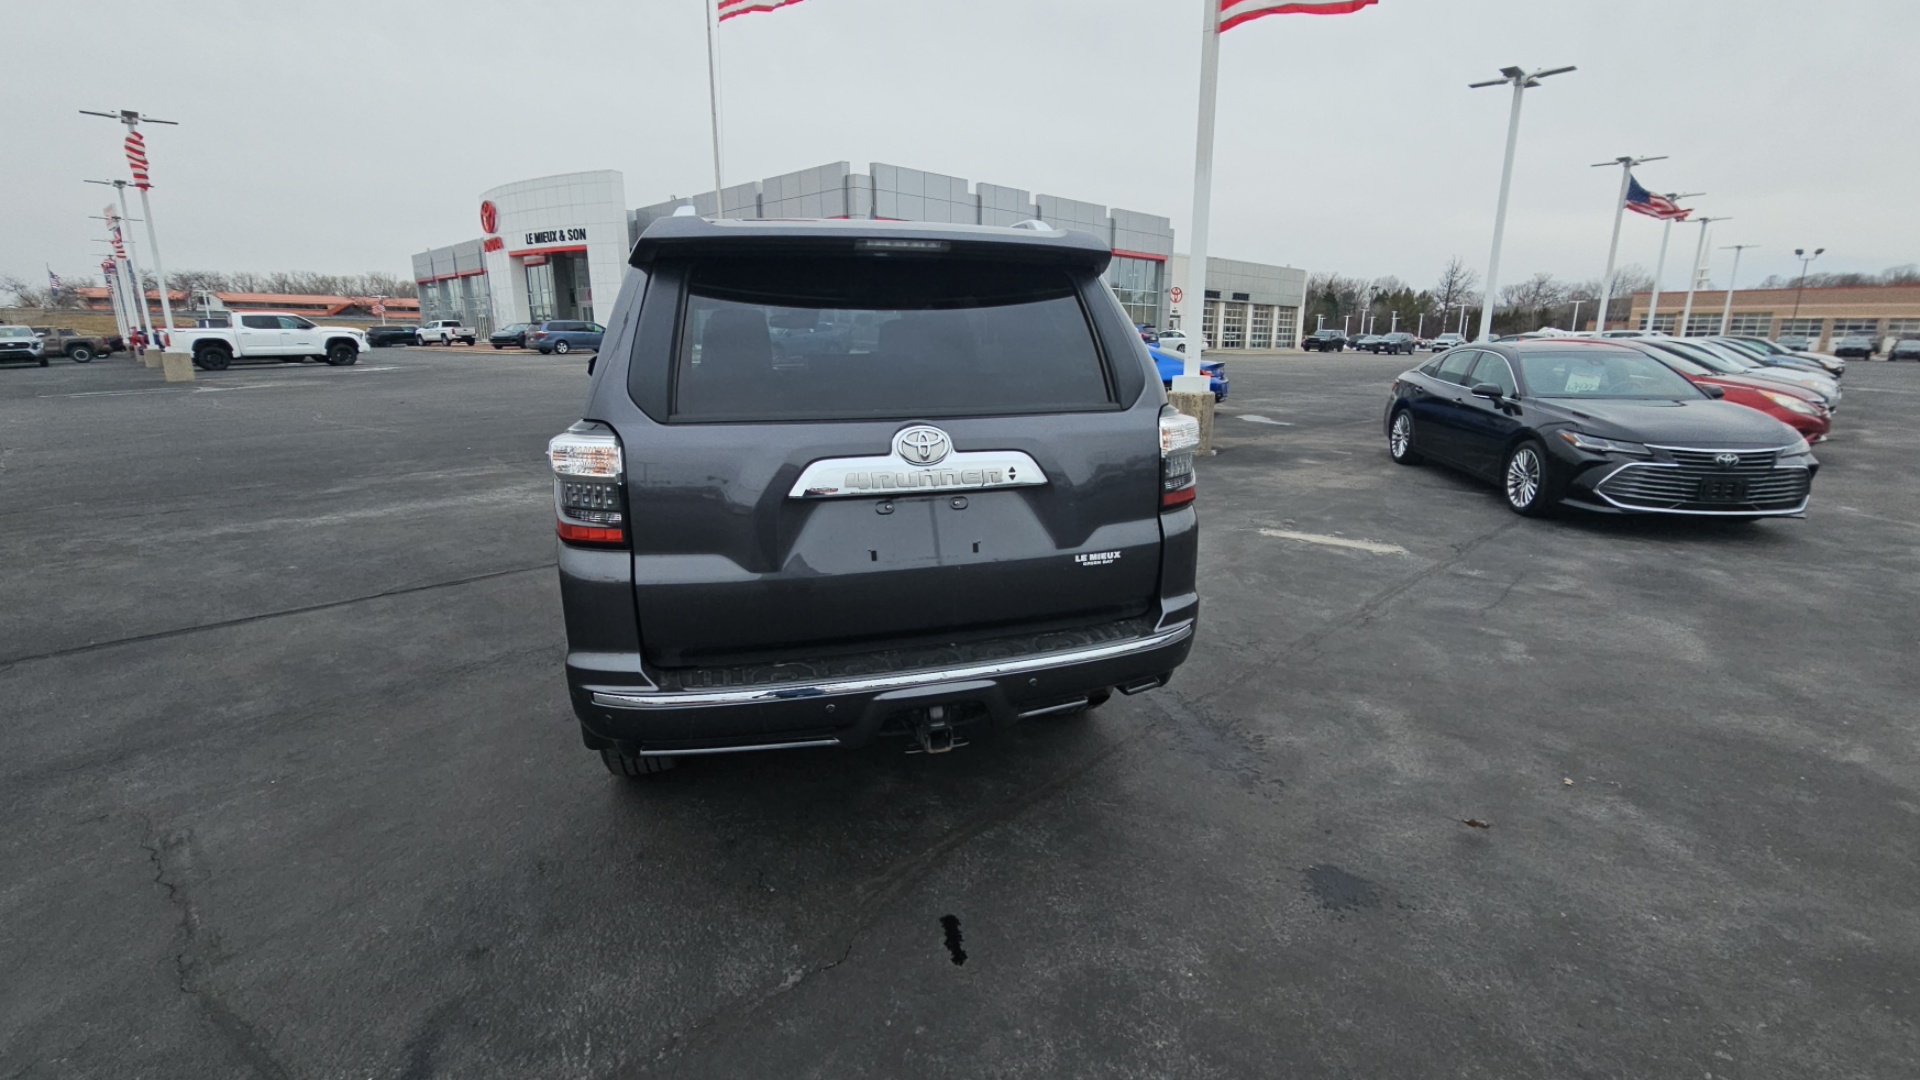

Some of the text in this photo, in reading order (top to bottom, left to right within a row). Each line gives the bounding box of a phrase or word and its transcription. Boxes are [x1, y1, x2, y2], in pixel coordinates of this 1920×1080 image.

[525, 228, 587, 245] LE MIEUX & SON
[1075, 550, 1121, 563] LE MIEUX
